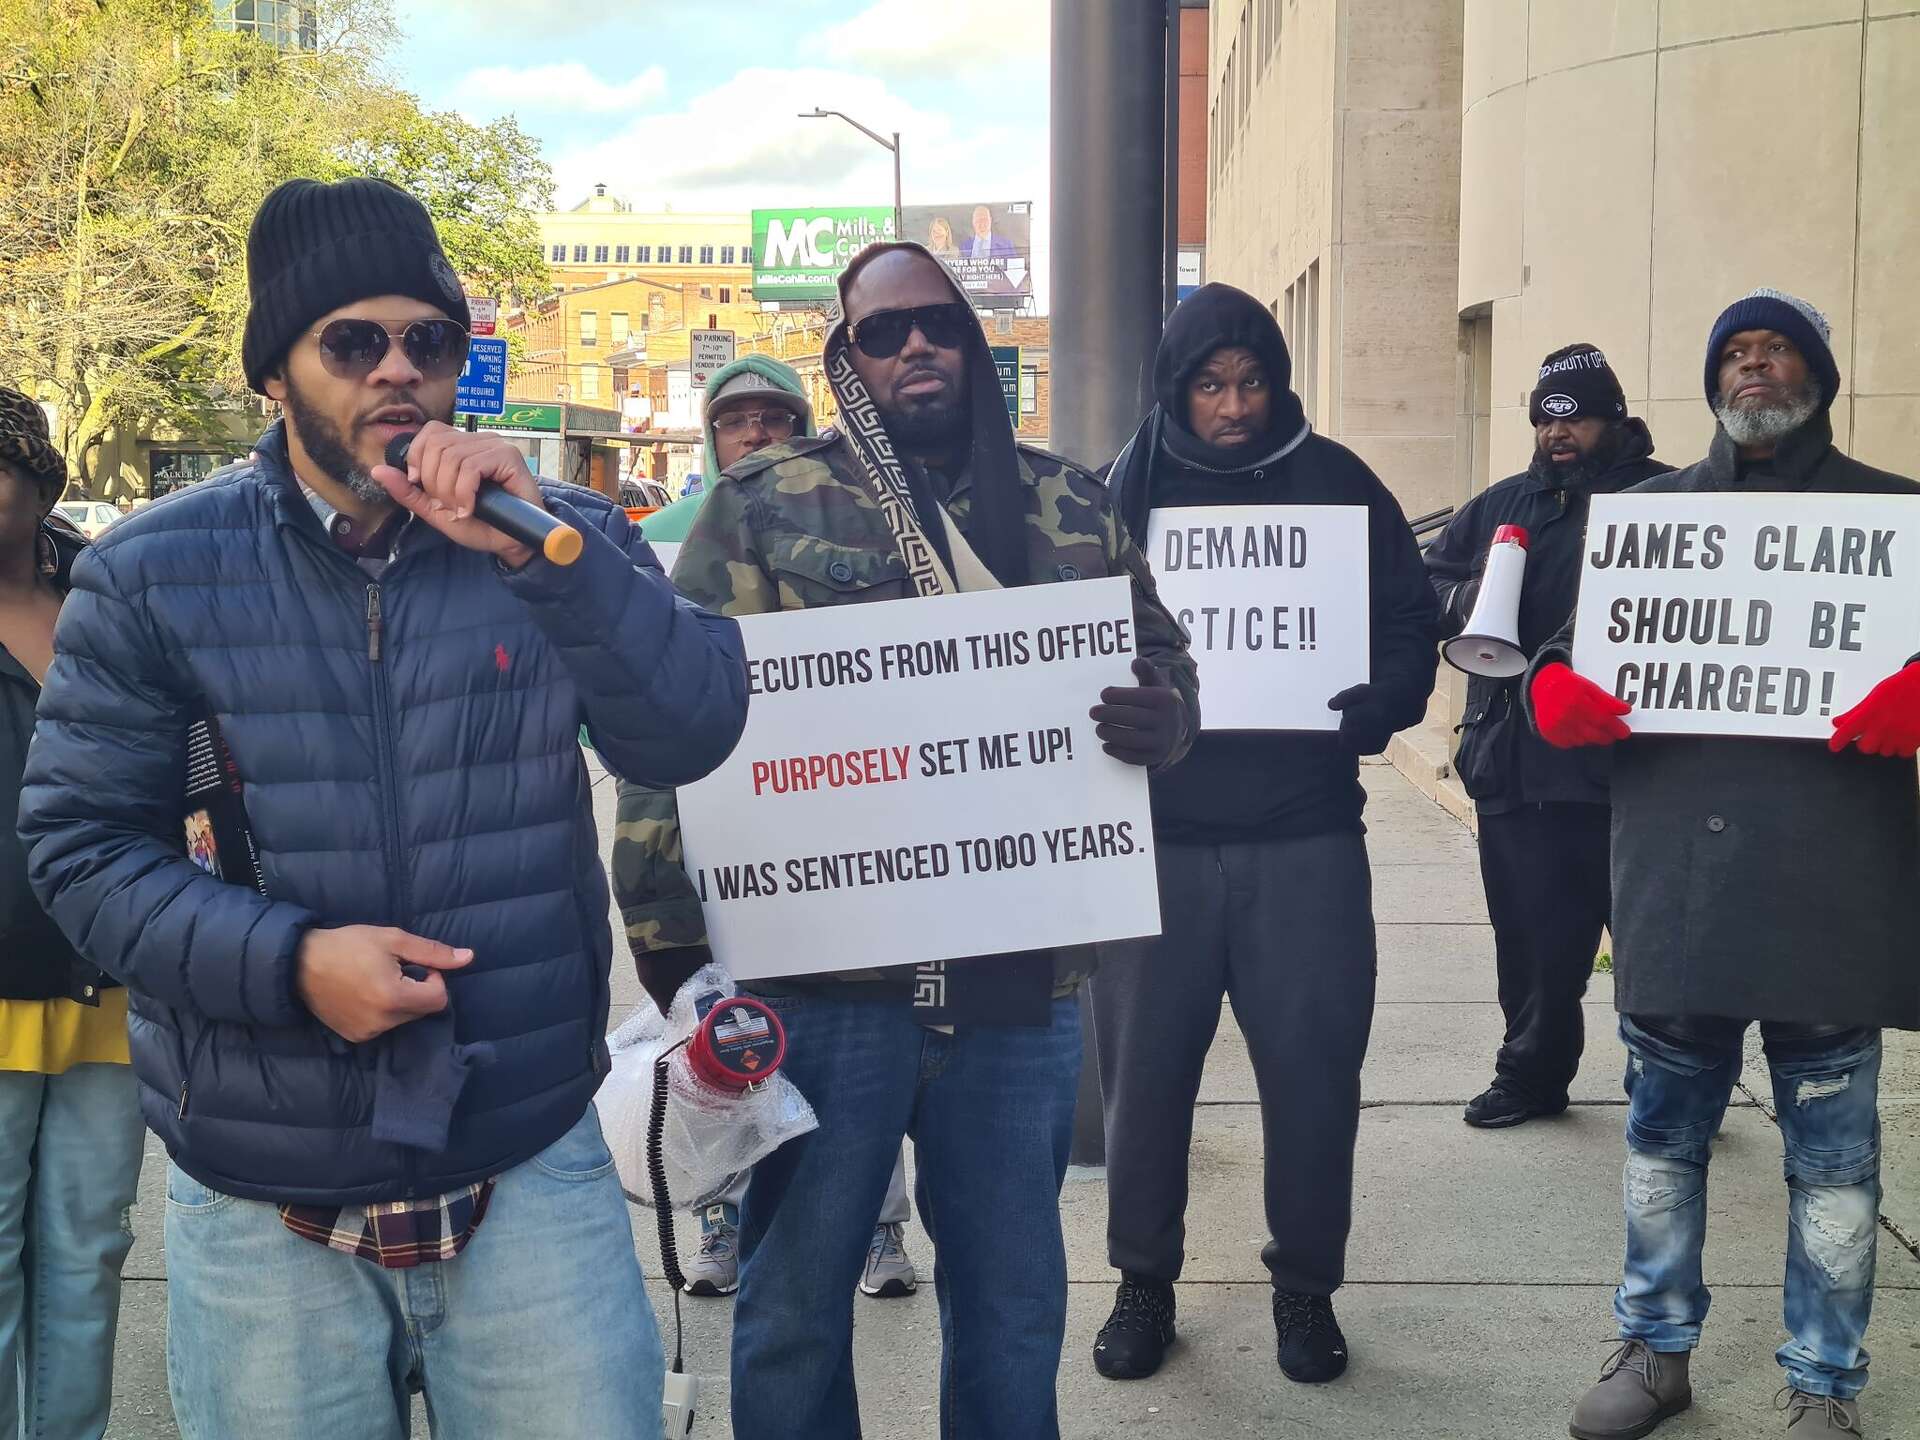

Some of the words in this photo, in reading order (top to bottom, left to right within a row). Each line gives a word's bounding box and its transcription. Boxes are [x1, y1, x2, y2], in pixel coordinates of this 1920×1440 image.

[836, 217, 877, 237] Mills
[882, 216, 895, 236] &
[763, 216, 834, 267] MC
[836, 235, 886, 257] Cah
[472, 344, 502, 353] RESERVED
[694, 334, 702, 342] NO
[704, 334, 732, 343] PARKING
[478, 354, 502, 364] PARKING
[488, 365, 501, 373] THIS
[1552, 354, 1591, 373] EQUITY
[483, 375, 501, 384] SPACE
[471, 387, 495, 396] REQUIRED
[1545, 402, 1573, 410] JETS
[1164, 524, 1307, 572] DEMAND
[1590, 523, 1727, 570] JAMES
[1754, 525, 1896, 578] CLARK
[1177, 606, 1316, 651] STICE!!
[1607, 597, 1773, 647] SHOULD
[1808, 600, 1867, 652] BE
[749, 648, 873, 695] ECUTORS
[879, 638, 960, 681] FROM
[965, 630, 1030, 670] THIS
[1037, 618, 1132, 662] OFFICE
[1615, 662, 1836, 716] CHARGED!
[752, 745, 910, 796] PURPOSELY
[919, 738, 970, 777] SET
[978, 732, 1022, 771] ME
[1027, 726, 1073, 765] UP!
[698, 868, 708, 902] I
[713, 861, 778, 901] WAS
[784, 843, 950, 894] SENTENCED
[1042, 820, 1145, 864] YEARS.
